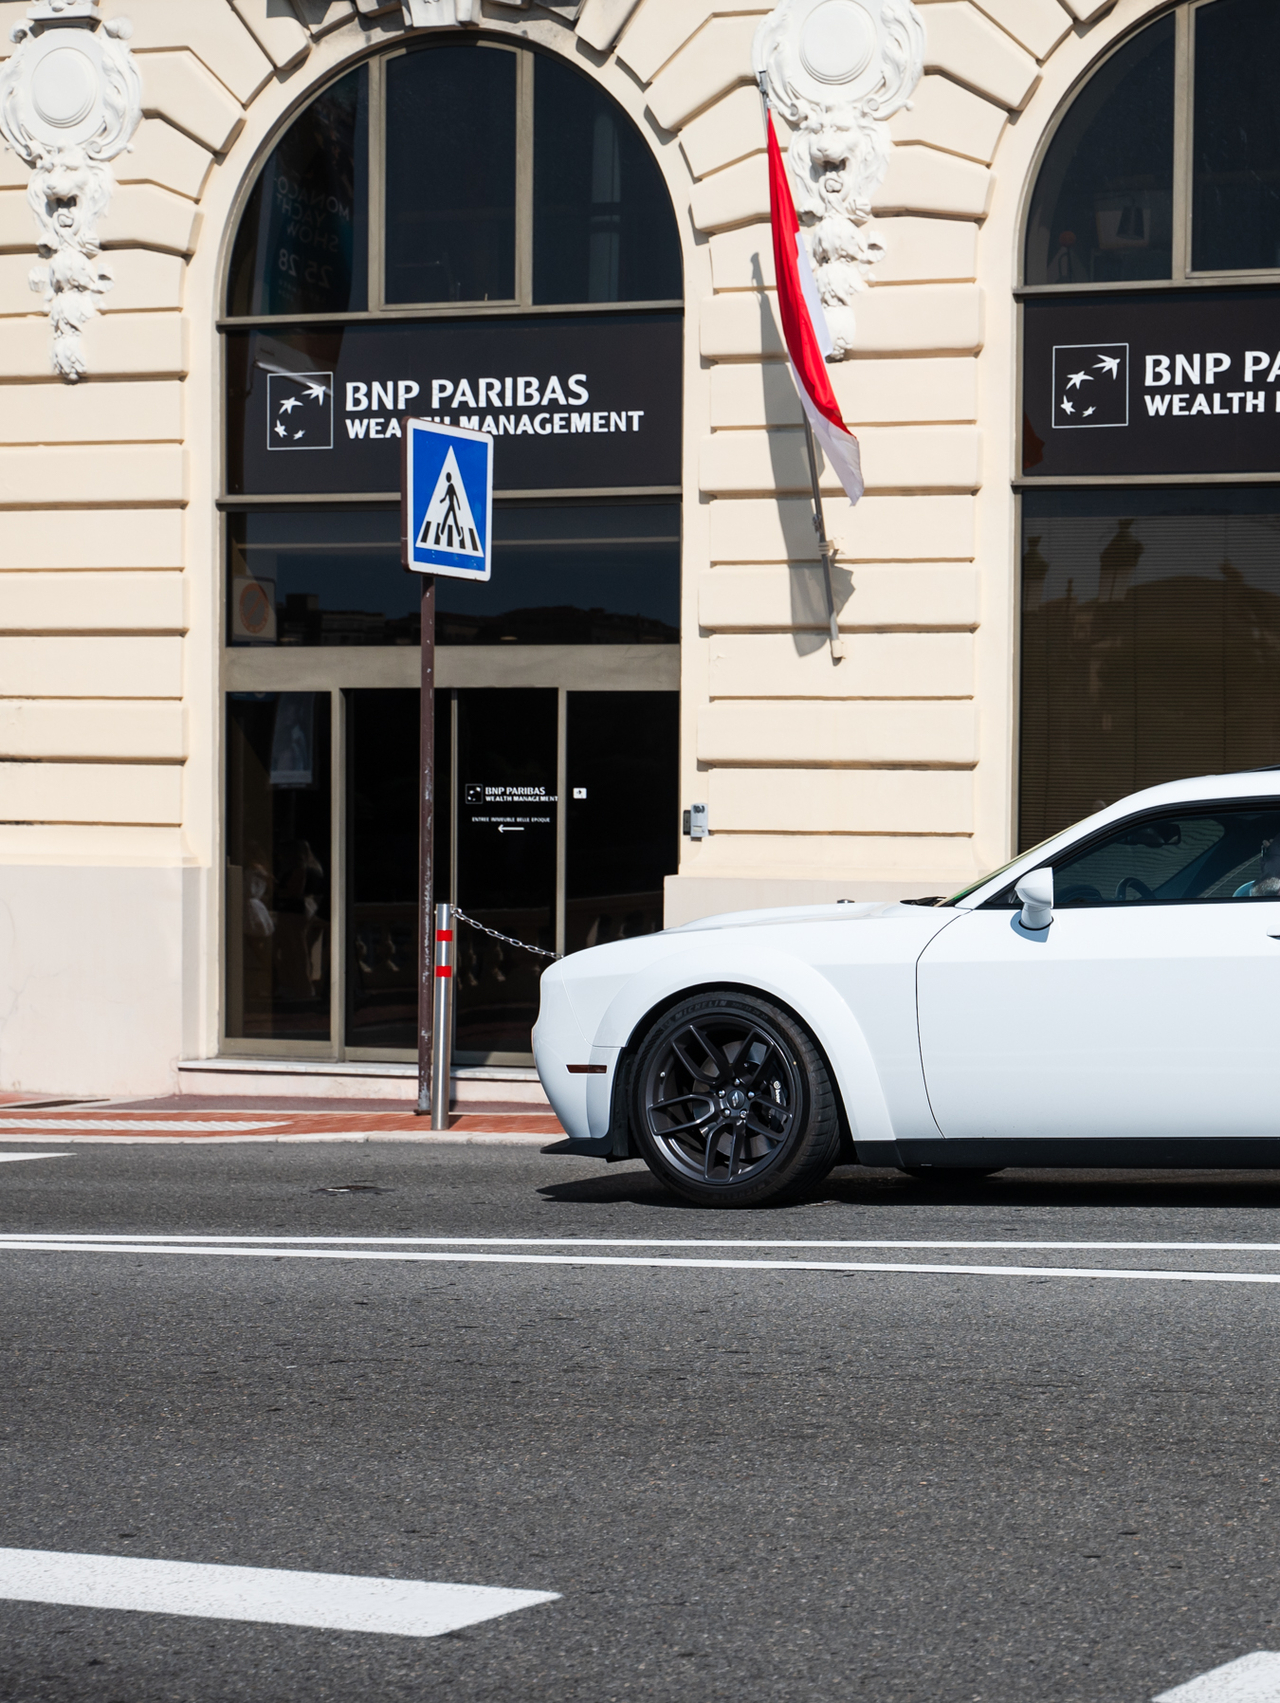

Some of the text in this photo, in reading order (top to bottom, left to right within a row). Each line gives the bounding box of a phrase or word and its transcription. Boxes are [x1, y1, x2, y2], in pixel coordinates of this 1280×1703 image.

[1144, 352, 1232, 387] BNP
[345, 373, 590, 412] BNP PARIBAS
[1143, 390, 1266, 417] WEALTH
[344, 410, 645, 440] WEA MANAGEMENT
[485, 787, 546, 795] BNP PARIBAS
[673, 1000, 727, 1021] MICHELIN
